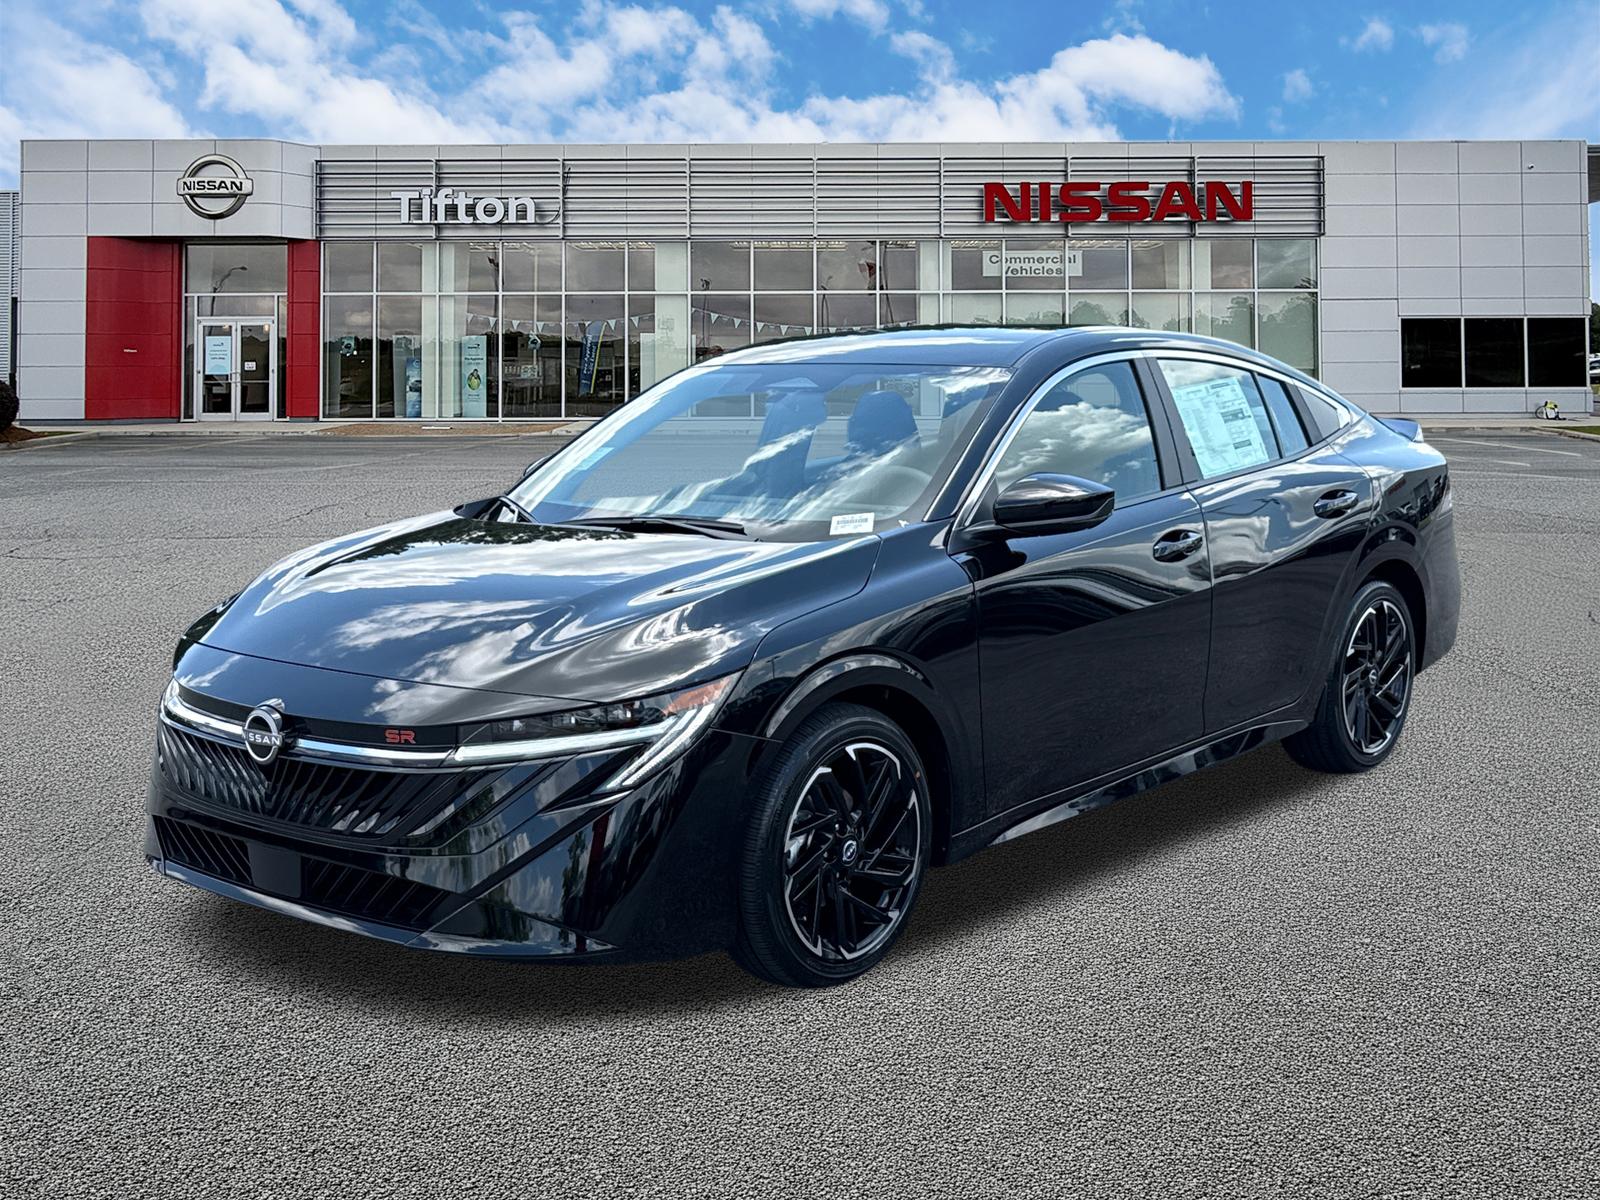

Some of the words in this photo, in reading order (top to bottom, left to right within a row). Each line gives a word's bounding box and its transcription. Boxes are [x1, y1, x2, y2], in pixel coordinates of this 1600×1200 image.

[182, 180, 243, 191] NISSAN
[390, 188, 537, 224] Tifton
[983, 181, 1254, 222] NISSAN
[242, 730, 280, 745] SSAN
[385, 729, 417, 744] SR
